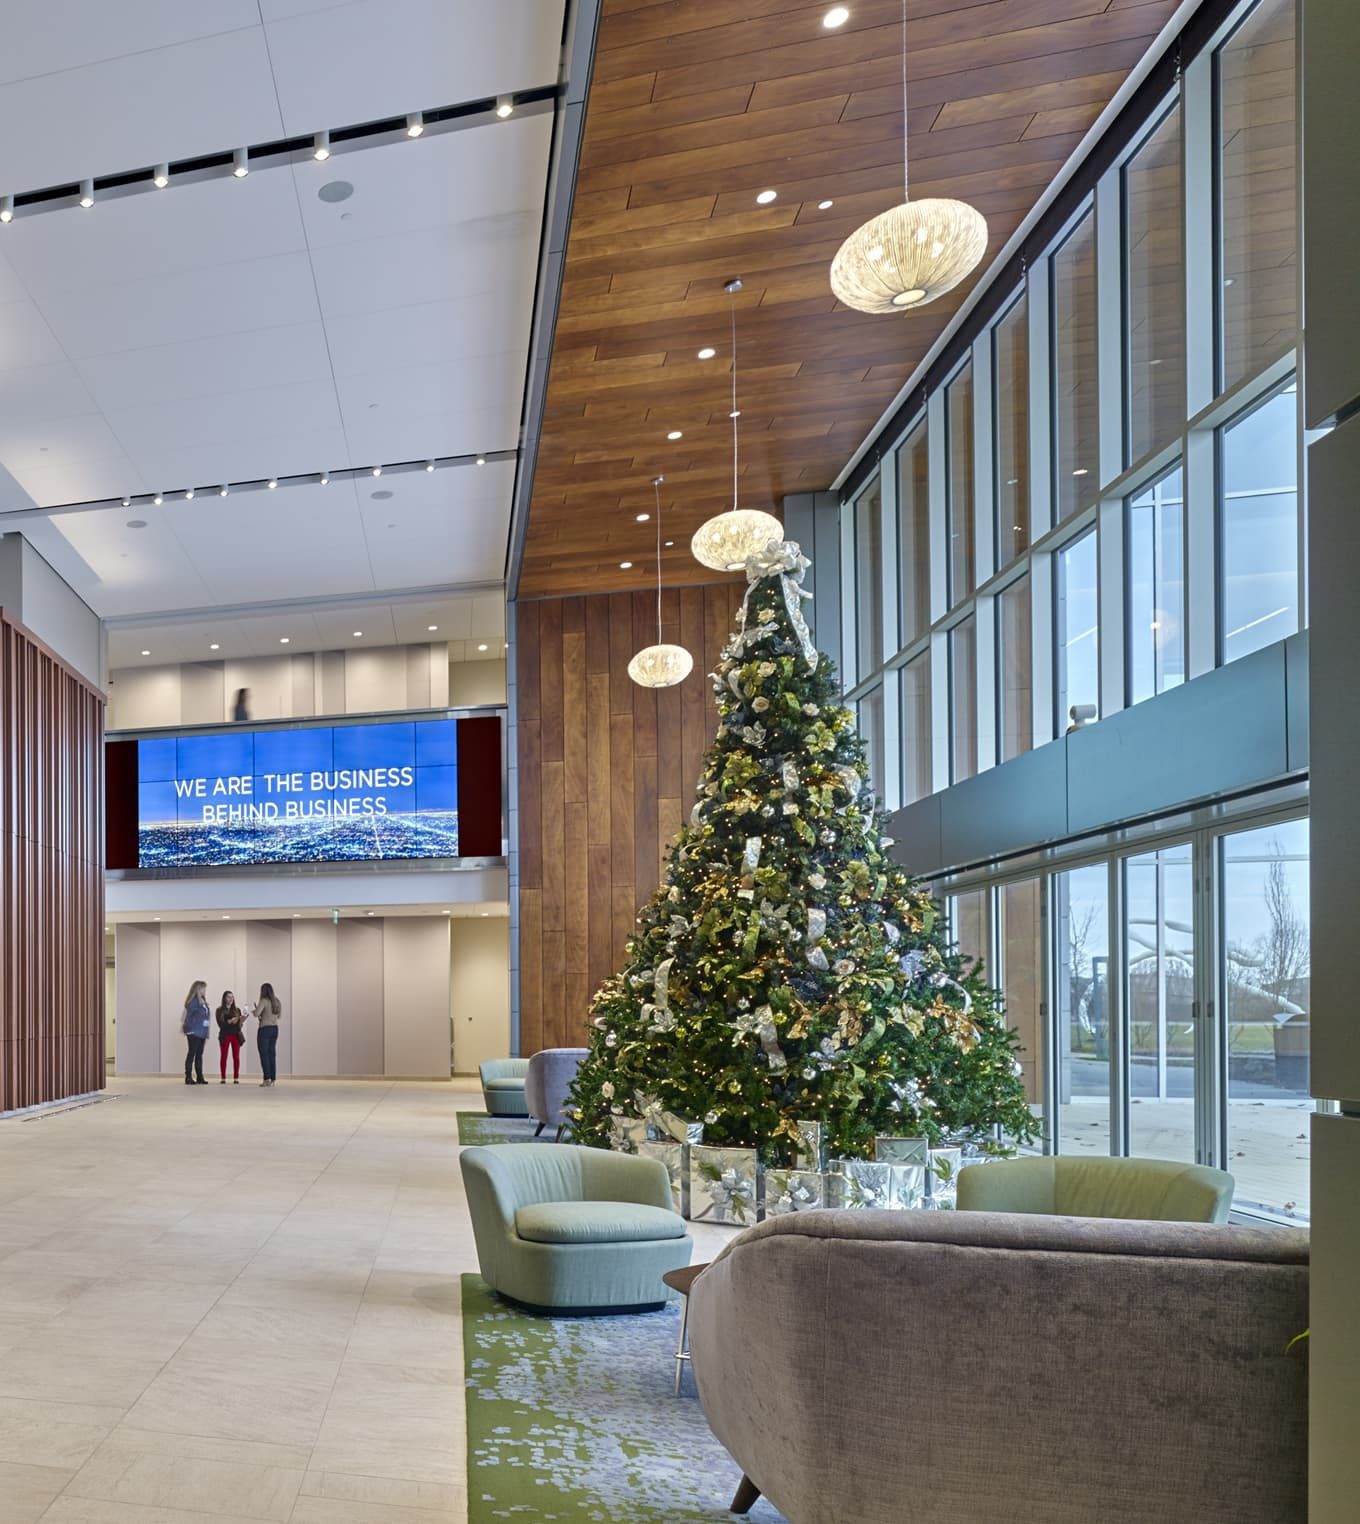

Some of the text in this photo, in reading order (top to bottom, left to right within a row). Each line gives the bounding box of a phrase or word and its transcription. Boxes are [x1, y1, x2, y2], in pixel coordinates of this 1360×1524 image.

[174, 766, 413, 798] WE ARE THE BUSINESS
[203, 796, 387, 823] BEHIND BUSINESS
